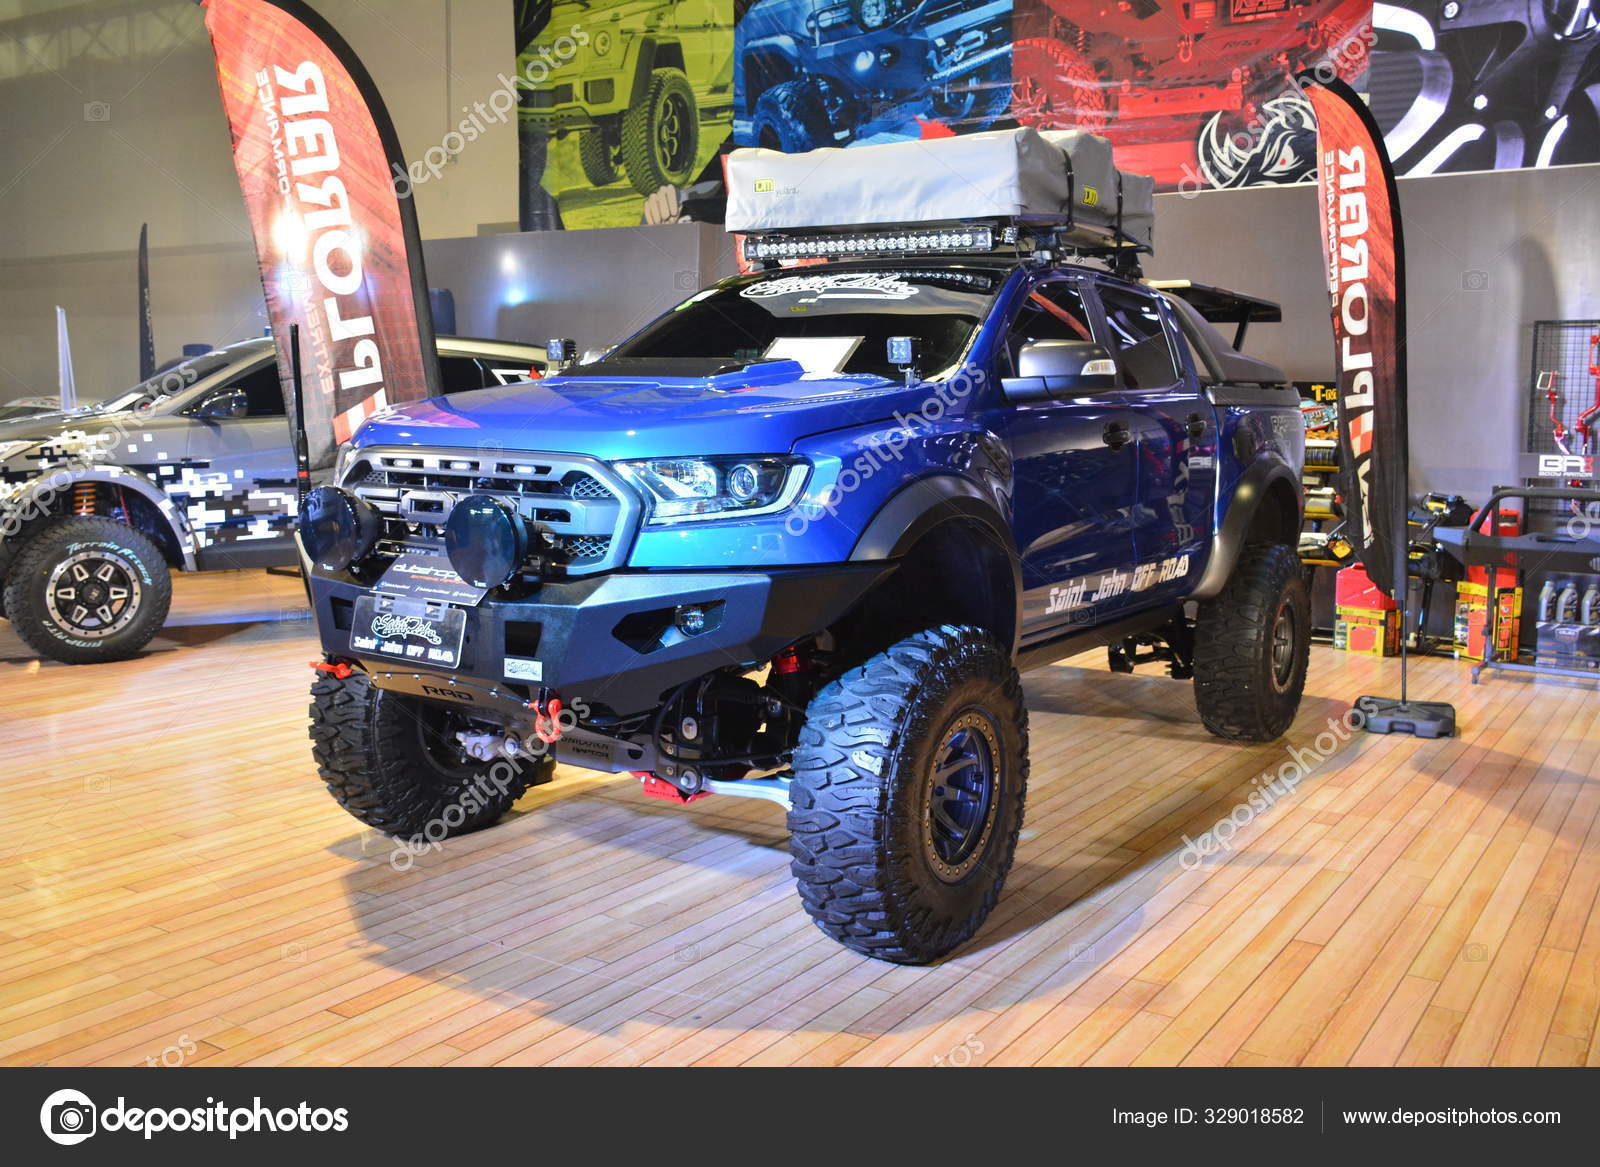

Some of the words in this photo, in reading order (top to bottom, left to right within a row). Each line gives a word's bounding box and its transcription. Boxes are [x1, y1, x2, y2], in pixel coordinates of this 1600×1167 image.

[66, 541, 120, 555] Terrain
[1045, 577, 1087, 614] Saint
[1091, 569, 1127, 602] John
[1131, 562, 1157, 591] OFF
[1158, 554, 1190, 583] ROAD
